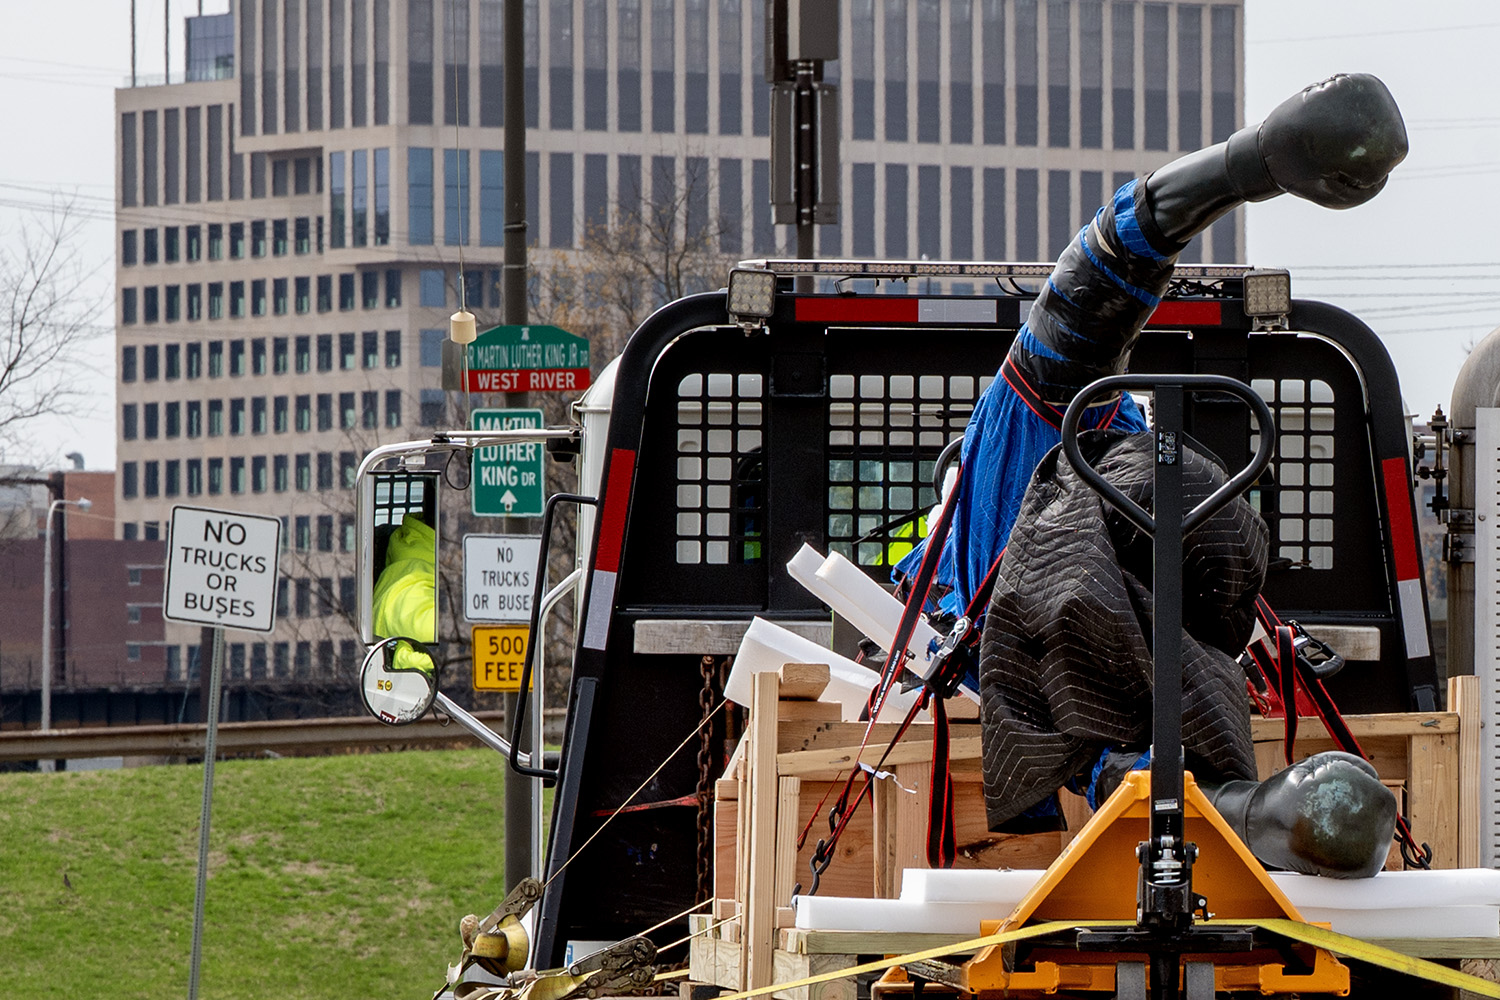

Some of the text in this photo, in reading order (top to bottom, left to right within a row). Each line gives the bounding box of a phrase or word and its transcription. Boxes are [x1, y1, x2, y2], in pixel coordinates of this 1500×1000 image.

[477, 345, 508, 369] MARTIN
[512, 344, 542, 368] LUTHER
[545, 343, 565, 367] KING
[568, 343, 577, 367] JR
[477, 372, 575, 389] WEST RIVER
[479, 442, 536, 462] LUTHER
[481, 466, 536, 487] KING DR
[204, 519, 247, 546] NO
[180, 546, 266, 574] TRUCKS
[497, 547, 513, 563] NO
[206, 573, 237, 592] OR
[482, 570, 530, 587] TRUCKS
[184, 592, 255, 617] BUSES
[473, 594, 534, 611] OR BUSE
[489, 636, 524, 655] 500
